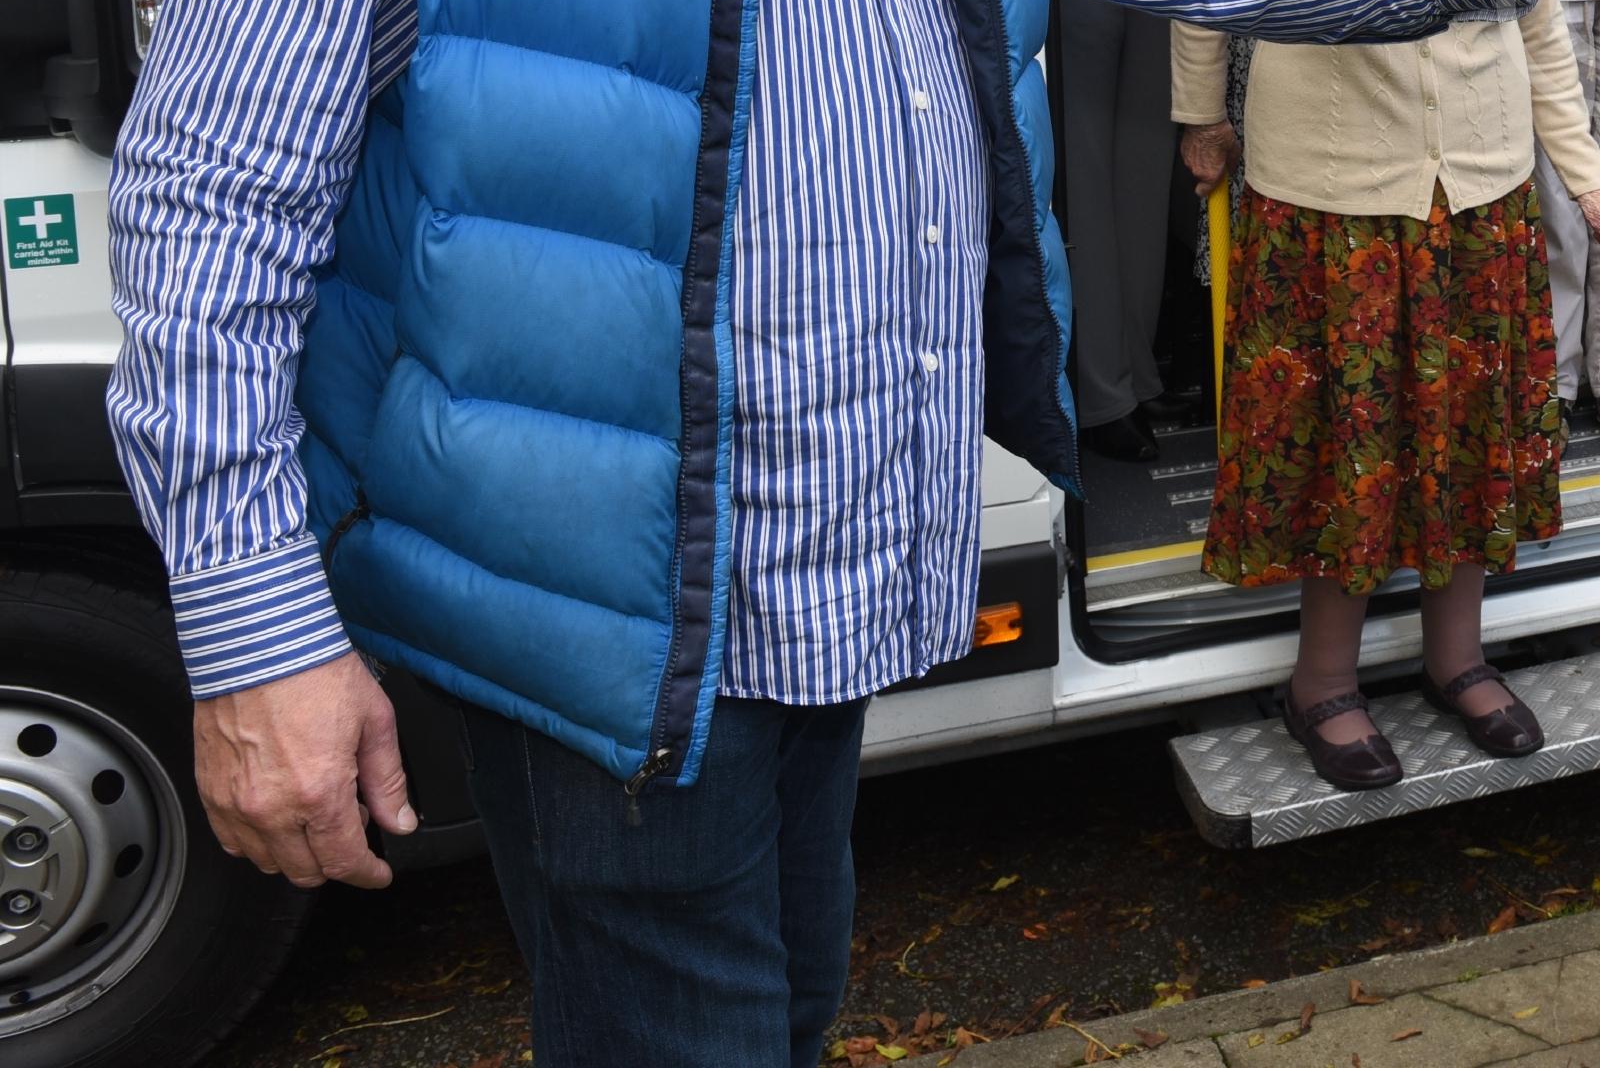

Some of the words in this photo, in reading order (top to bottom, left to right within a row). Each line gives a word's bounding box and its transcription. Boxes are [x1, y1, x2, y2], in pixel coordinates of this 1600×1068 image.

[16, 242, 36, 250] First
[39, 240, 53, 248] Aid
[14, 250, 45, 259] carried
[48, 247, 74, 256] within
[27, 257, 61, 266] minibus
